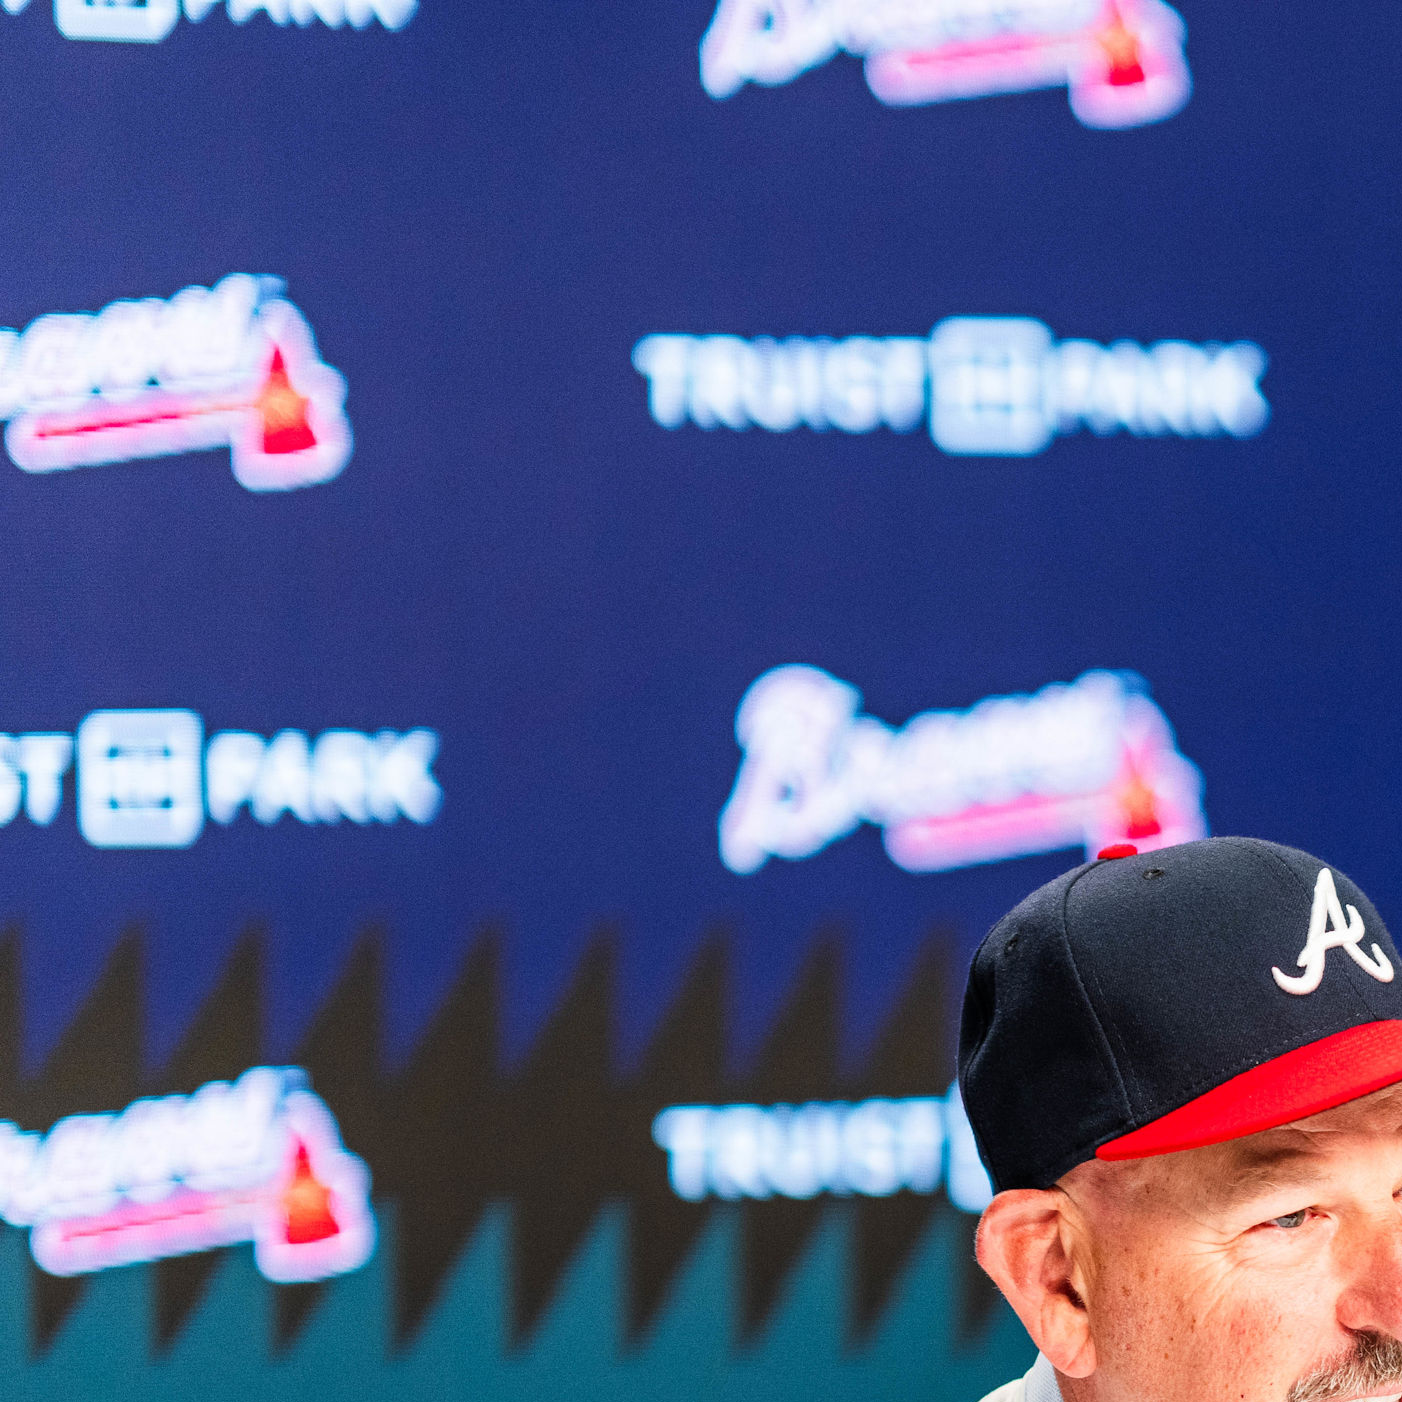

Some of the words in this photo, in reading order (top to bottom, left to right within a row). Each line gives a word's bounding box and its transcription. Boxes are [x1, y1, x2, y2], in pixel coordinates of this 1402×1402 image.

[634, 333, 930, 433] TRUIST
[1050, 338, 1267, 437] PARK
[206, 727, 440, 825] PARK
[1271, 867, 1395, 995] A
[656, 1101, 950, 1202] TRUIST
